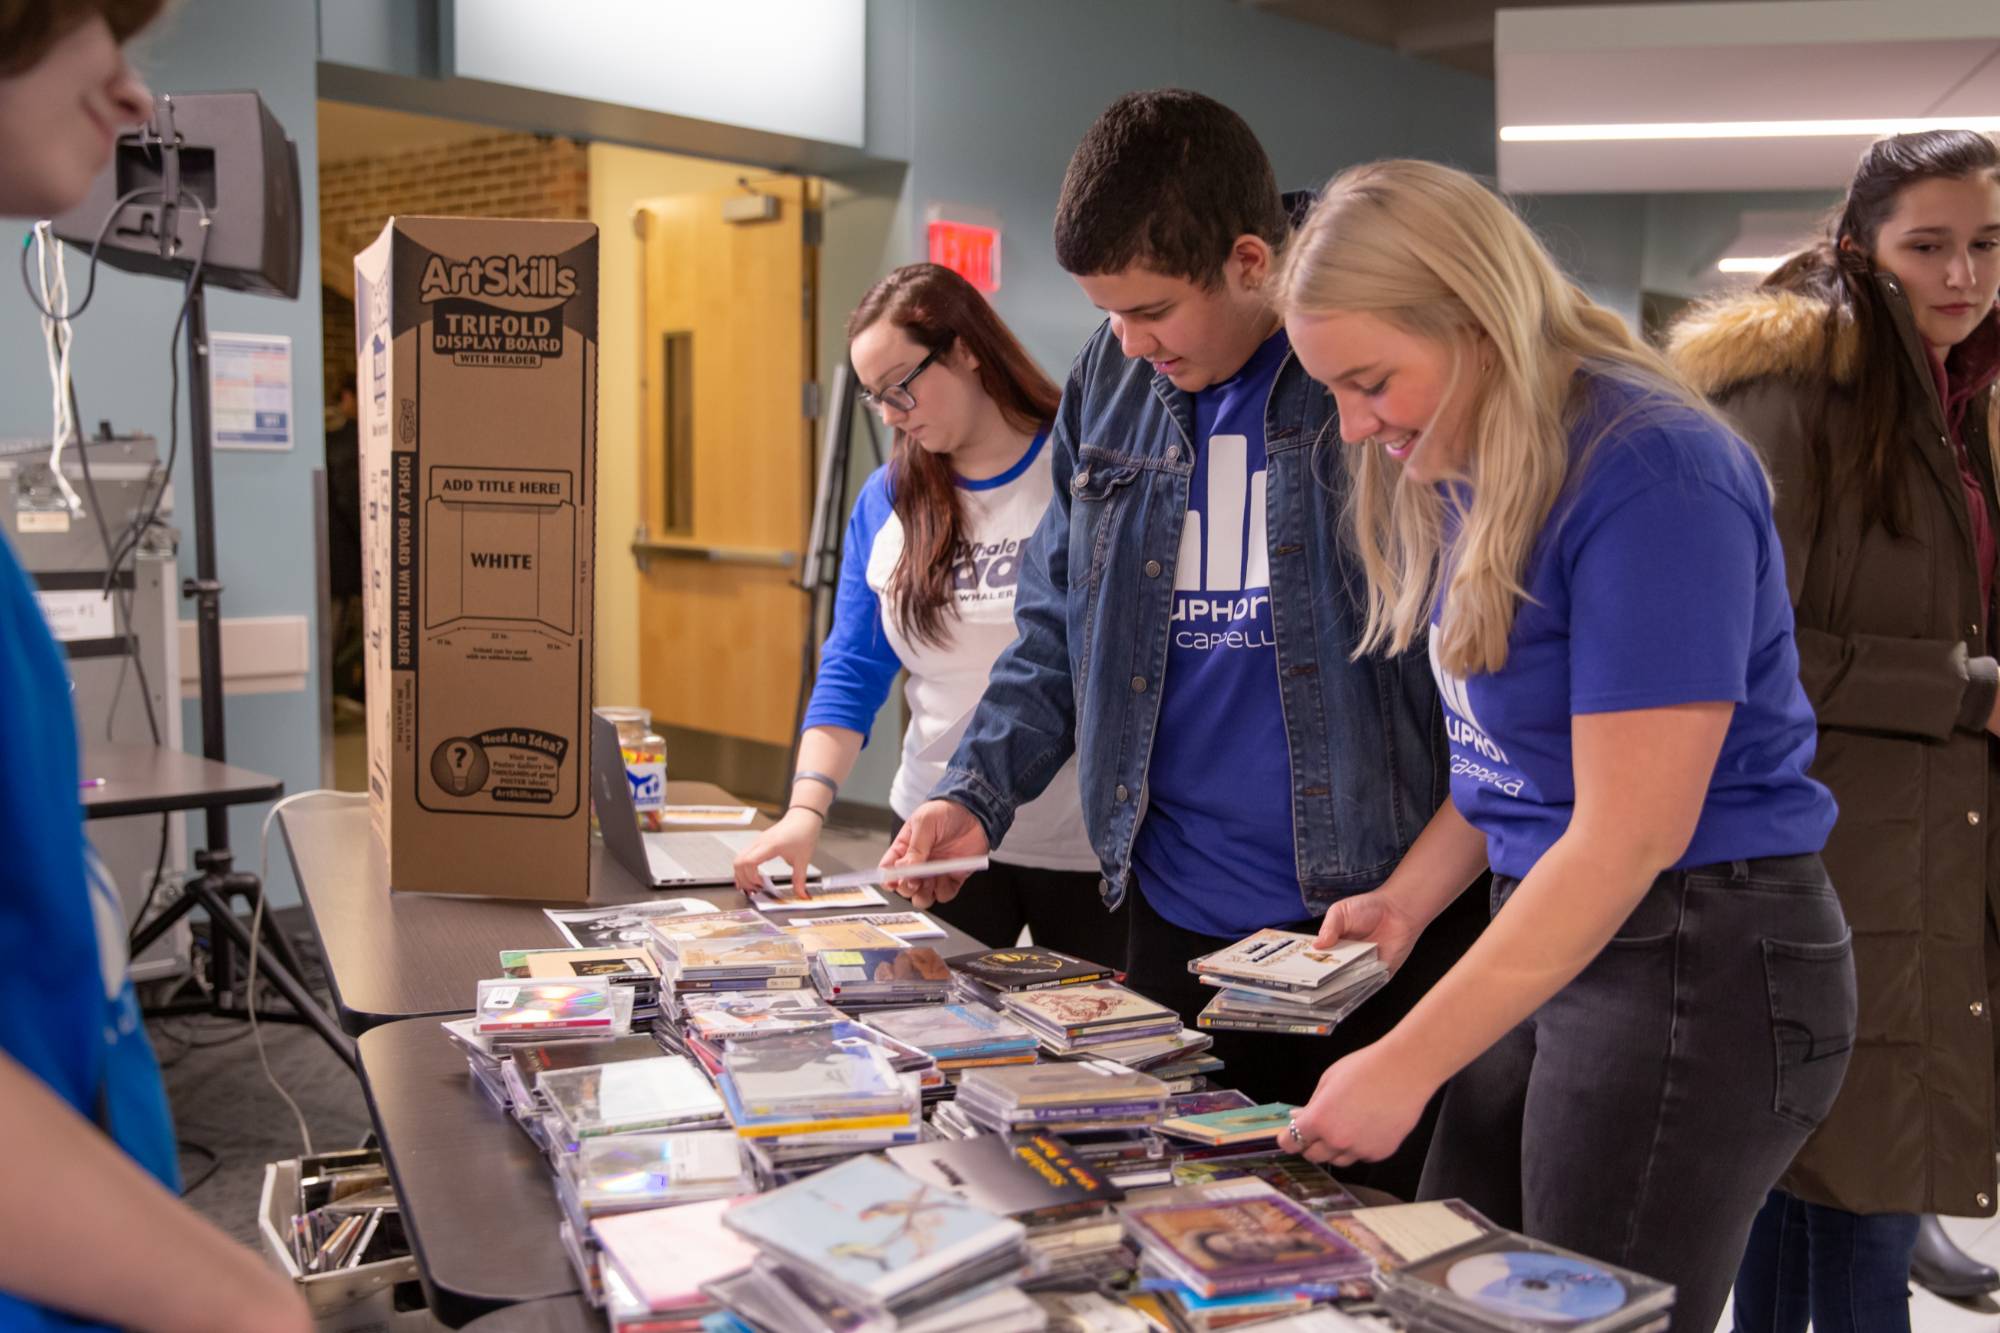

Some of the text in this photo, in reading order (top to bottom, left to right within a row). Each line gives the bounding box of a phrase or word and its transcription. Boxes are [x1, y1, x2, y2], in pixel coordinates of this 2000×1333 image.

[420, 254, 578, 297] ArtSkills
[445, 314, 550, 337] TRIFOLD
[435, 335, 560, 352] DISPLAY BOARD
[460, 354, 537, 365] WITH HEADER
[398, 456, 411, 514] DISPLAY
[442, 480, 560, 495] ADD TITLE HERE!
[398, 518, 411, 566] BOARD
[470, 552, 532, 570] WHITE
[398, 570, 411, 606] WITH
[398, 610, 411, 665] HEADER
[481, 732, 563, 754] Need An Idea?
